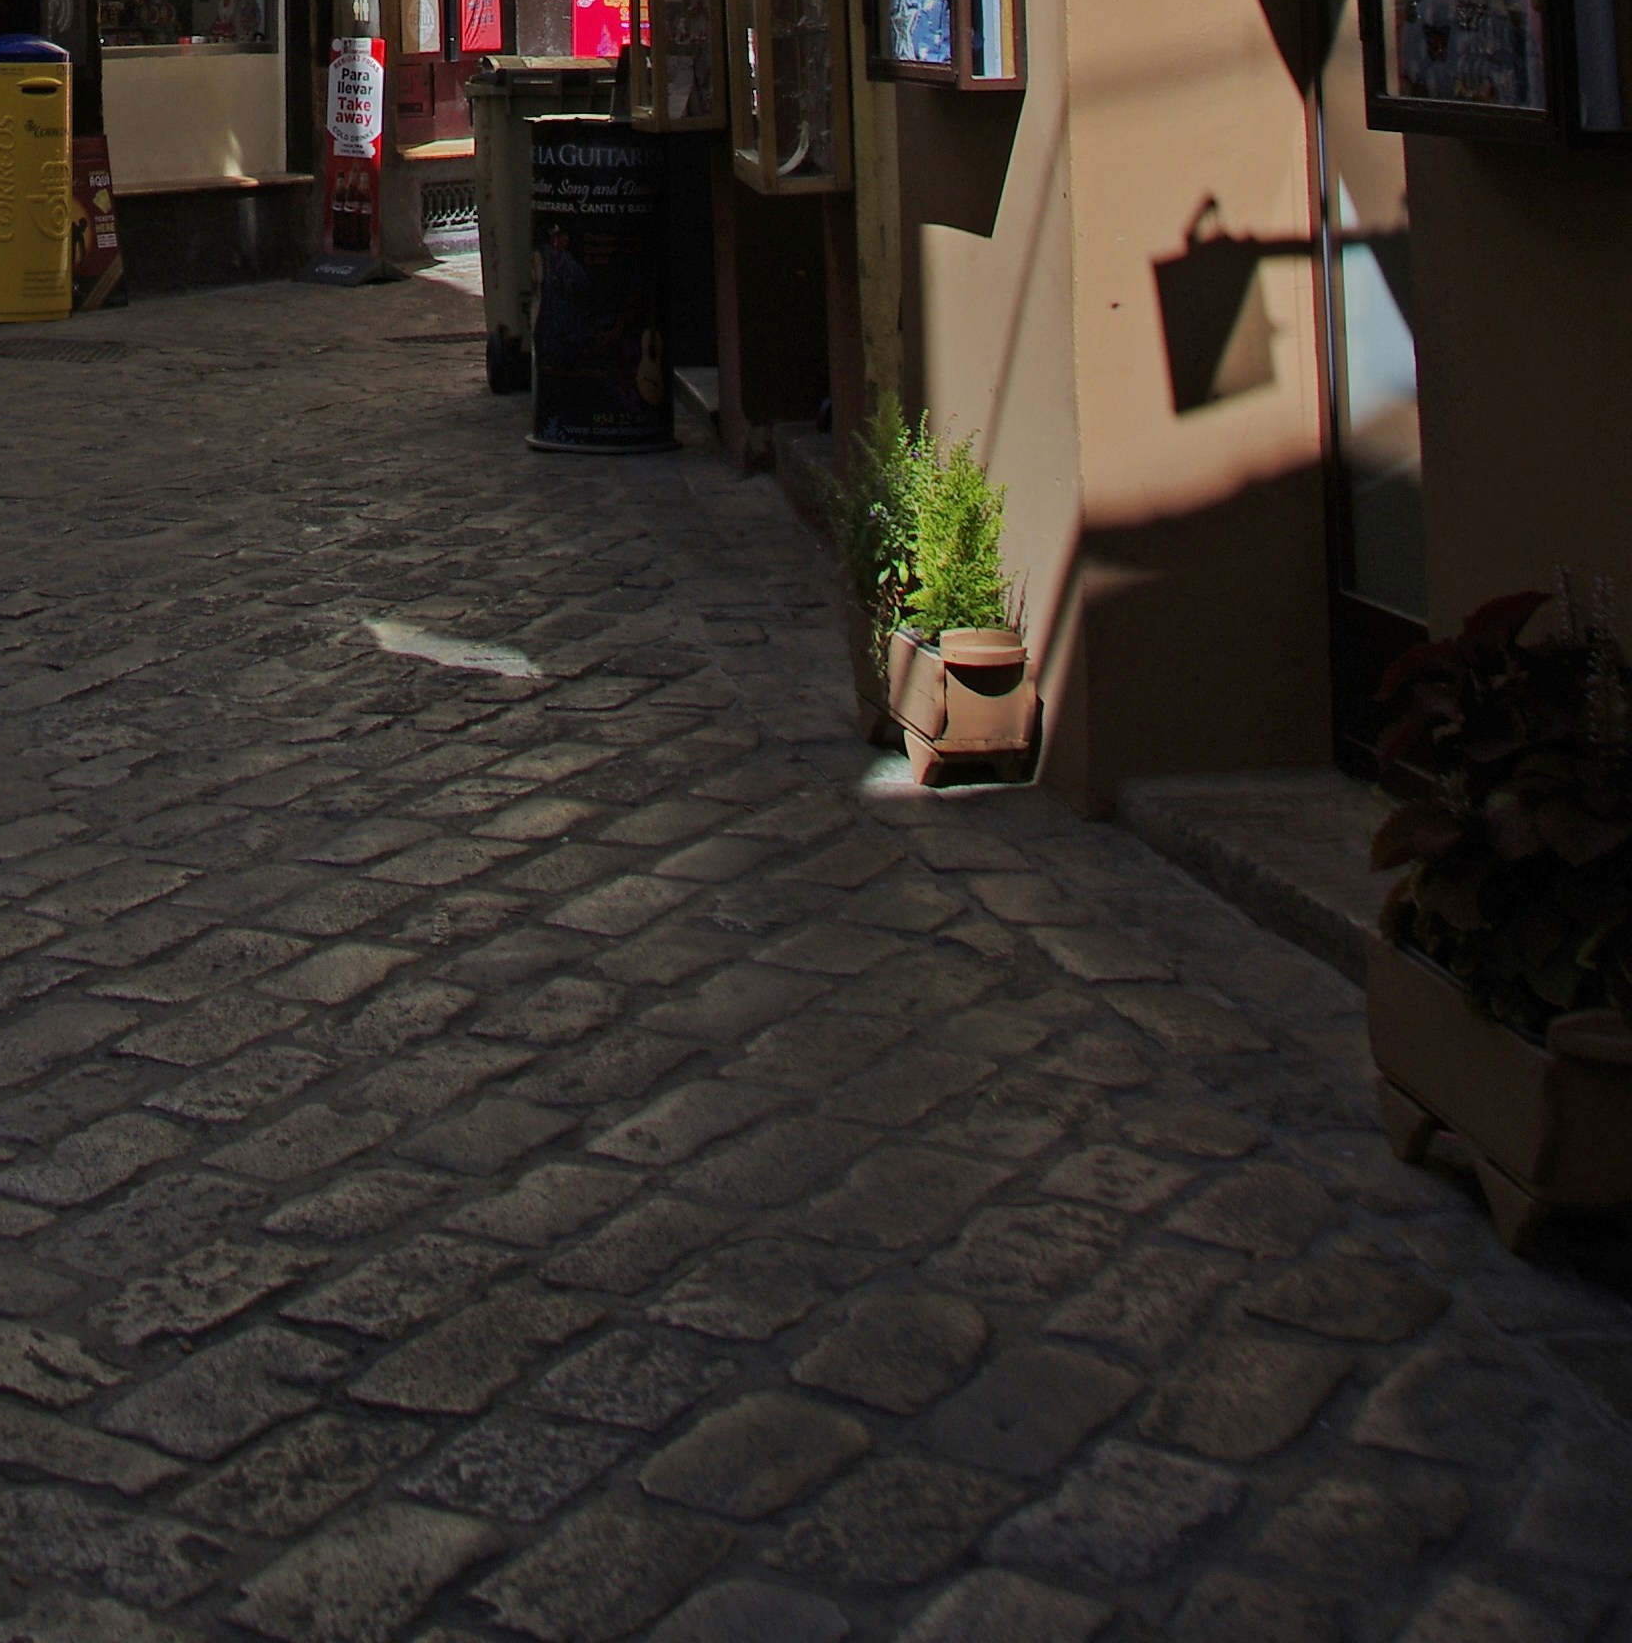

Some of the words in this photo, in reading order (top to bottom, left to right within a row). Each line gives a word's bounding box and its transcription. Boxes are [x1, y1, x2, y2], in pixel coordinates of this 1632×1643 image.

[341, 67, 370, 82] Para
[337, 81, 374, 96] llevar
[337, 97, 372, 112] Take
[335, 112, 372, 127] away
[332, 125, 349, 142] COLD
[349, 128, 375, 143] DRINKS
[558, 178, 590, 203] Song
[592, 177, 622, 196] and
[580, 203, 616, 214] CANTE
[618, 204, 626, 214] Y
